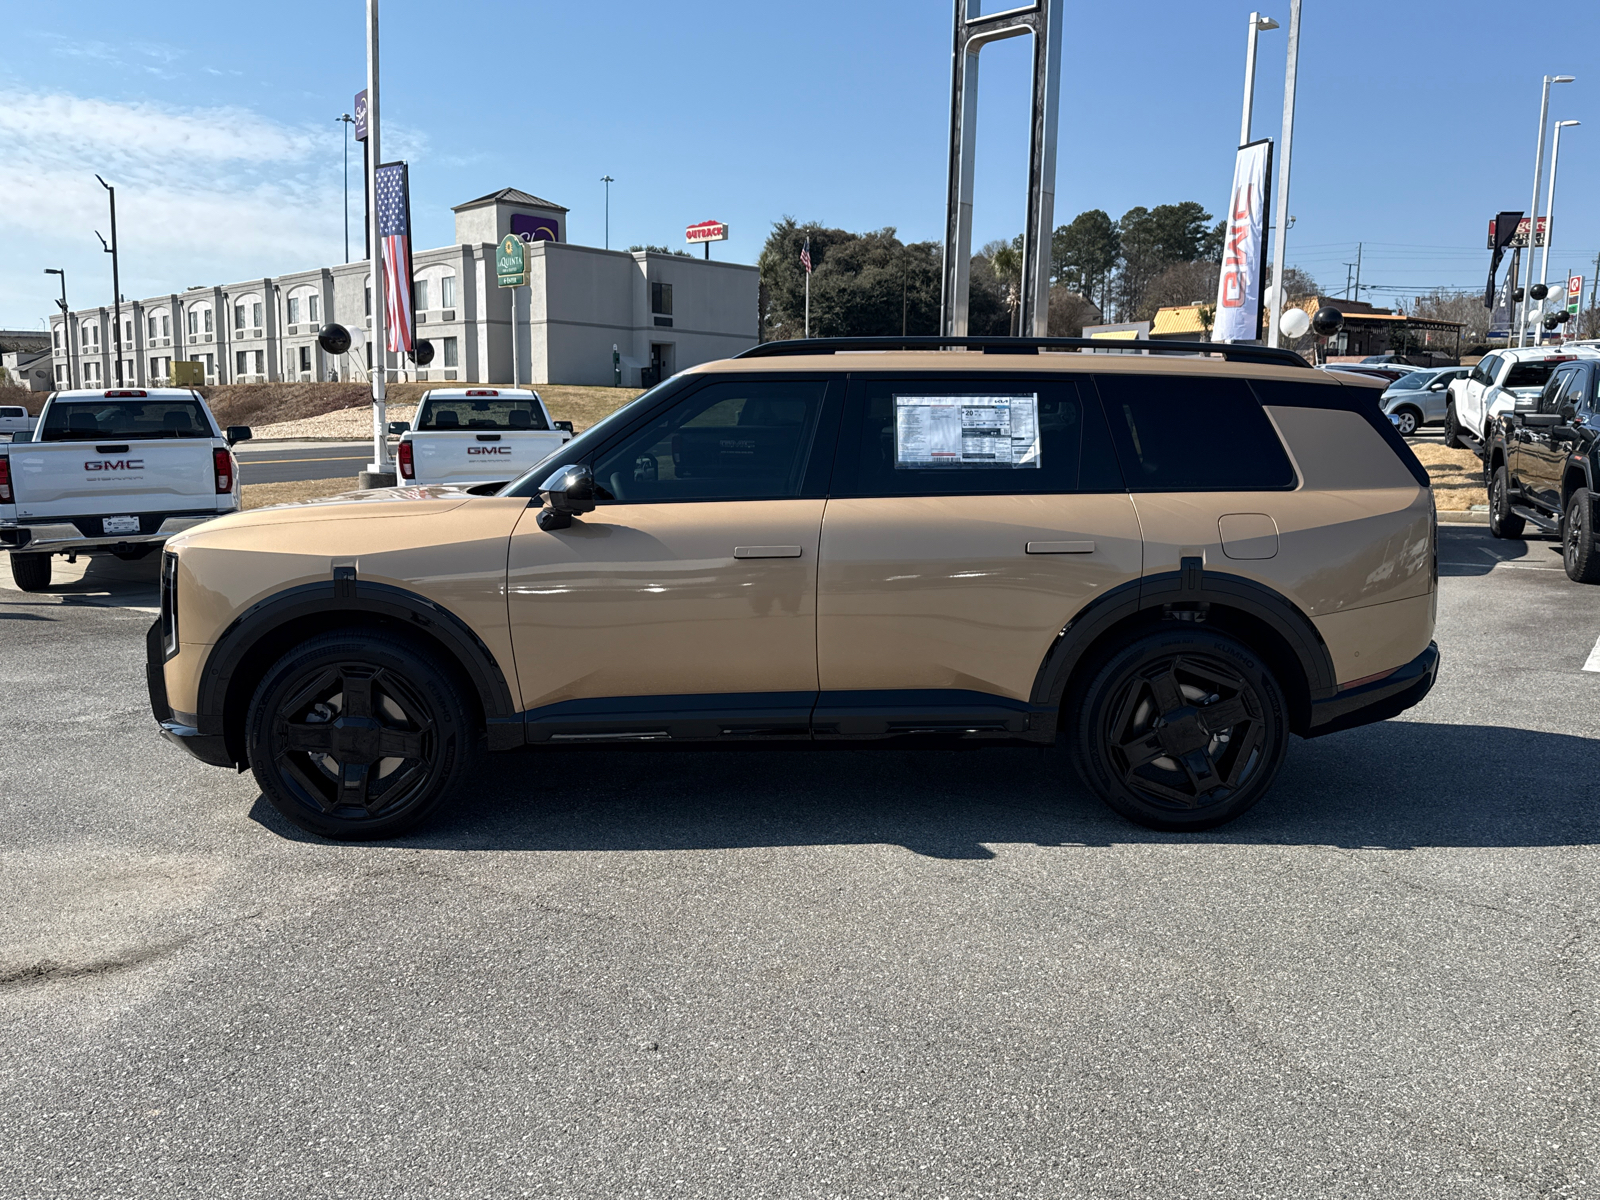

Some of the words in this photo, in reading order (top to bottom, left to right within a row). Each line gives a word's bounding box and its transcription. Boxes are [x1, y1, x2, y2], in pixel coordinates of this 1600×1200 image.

[686, 226, 722, 239] OUTBACK
[467, 446, 512, 455] GMC
[84, 459, 145, 471] GMC
[379, 650, 405, 664] OUTSIDE
[1213, 641, 1256, 669] KUMHO
[424, 679, 452, 723] KUMHO
[254, 759, 283, 802] KUMHO
